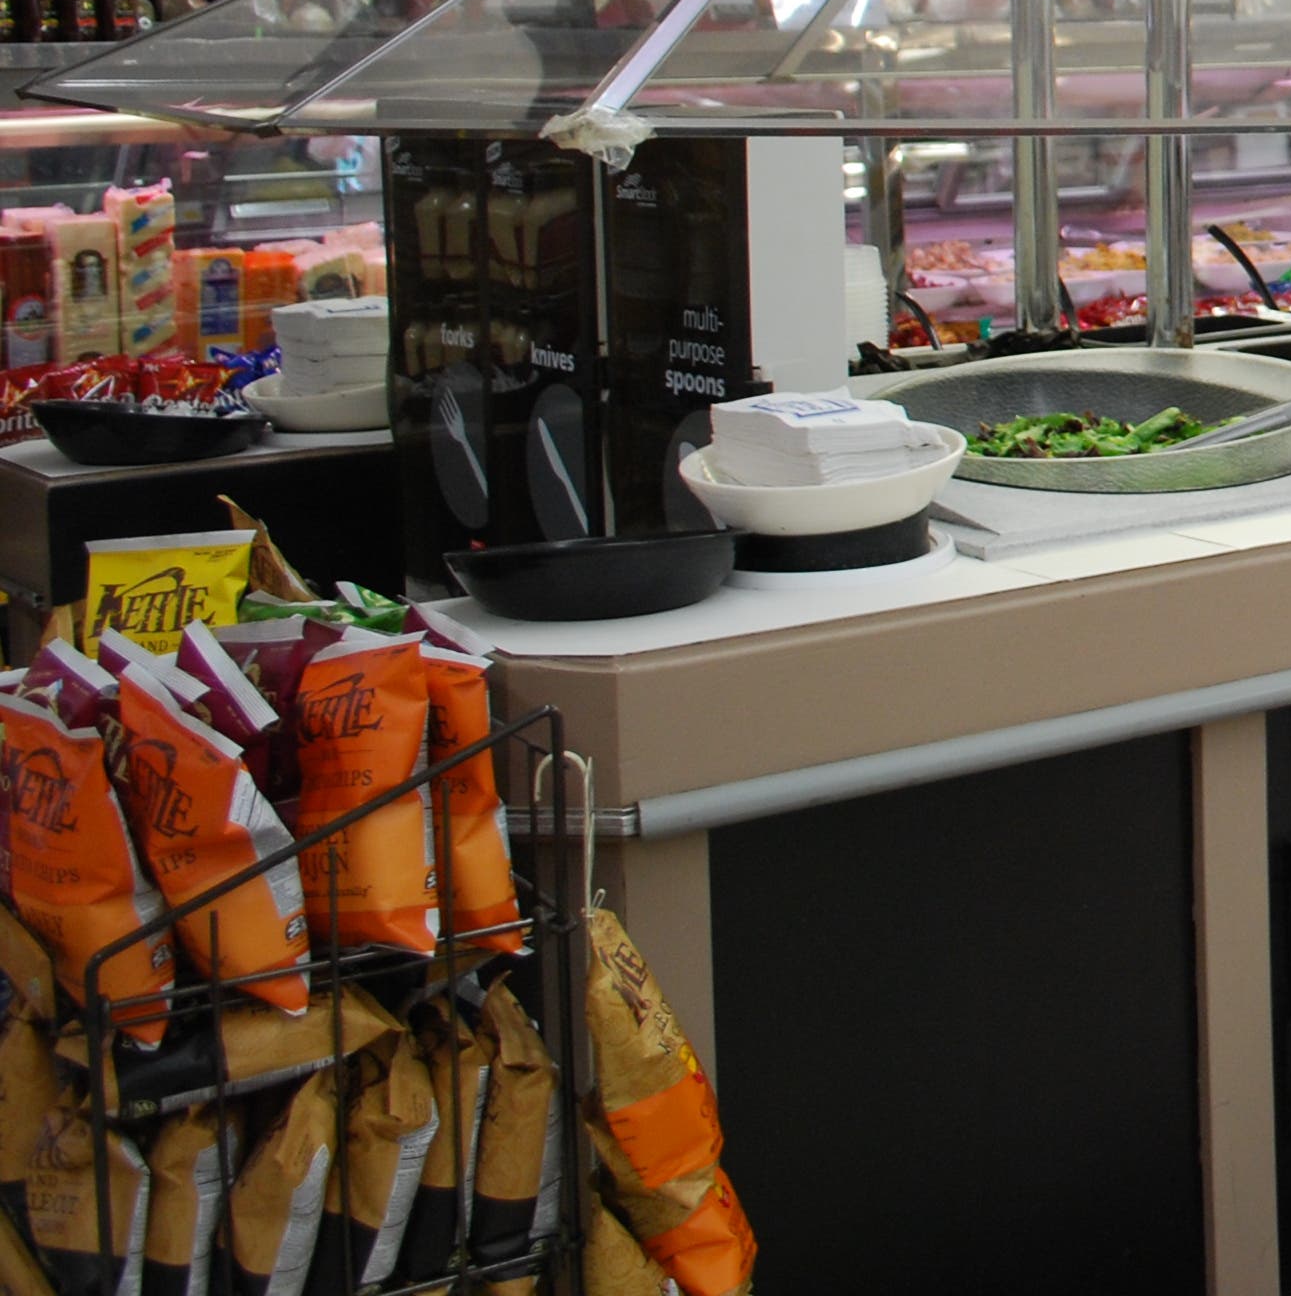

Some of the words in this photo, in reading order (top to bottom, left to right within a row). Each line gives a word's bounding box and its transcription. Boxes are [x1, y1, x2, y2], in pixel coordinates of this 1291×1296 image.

[683, 306, 725, 333] multi-
[440, 323, 476, 349] forks
[530, 342, 576, 373] knives
[669, 338, 726, 370] purpose
[664, 370, 727, 399] spoons
[88, 566, 217, 639] KETTLE
